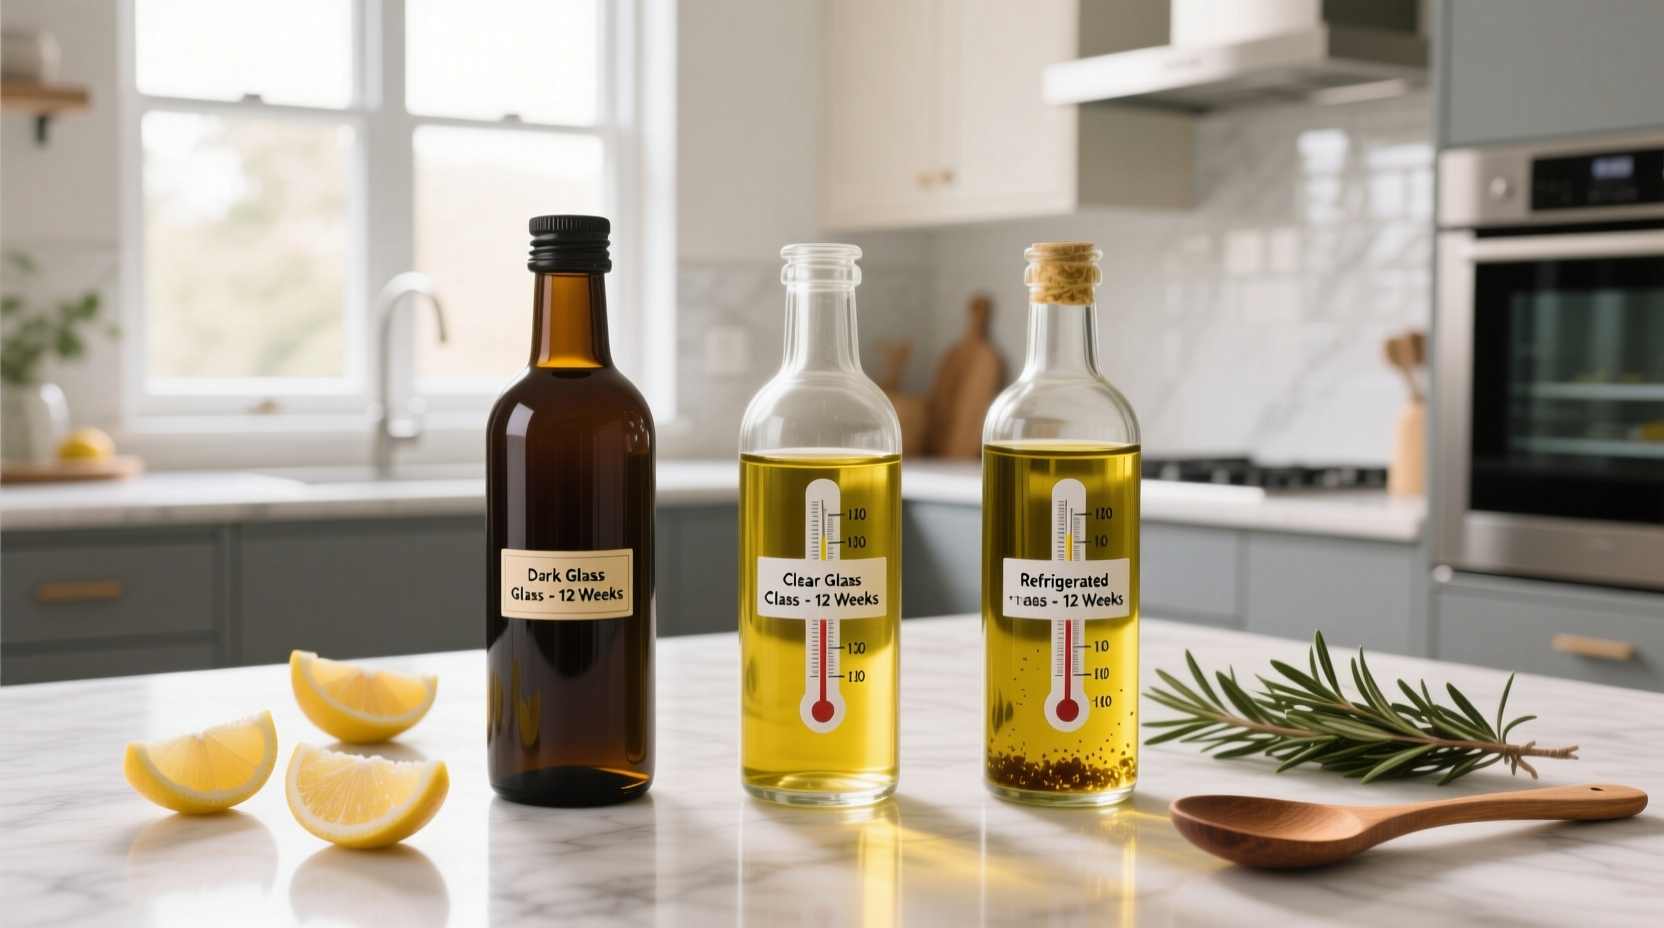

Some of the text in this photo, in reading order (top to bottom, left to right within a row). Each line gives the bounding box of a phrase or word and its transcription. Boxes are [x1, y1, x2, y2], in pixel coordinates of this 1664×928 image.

[528, 568, 605, 582] Dark Glass
[783, 572, 862, 587] Clear Glass
[1020, 572, 1109, 592] Refrigerated
[511, 586, 545, 602] Glass
[558, 588, 576, 602] 12
[577, 586, 624, 602] Weeks
[764, 590, 800, 606] Class
[815, 593, 831, 607] 12
[833, 590, 879, 607] Weeks
[1062, 593, 1079, 608] 12
[1081, 591, 1124, 608] Weeks
